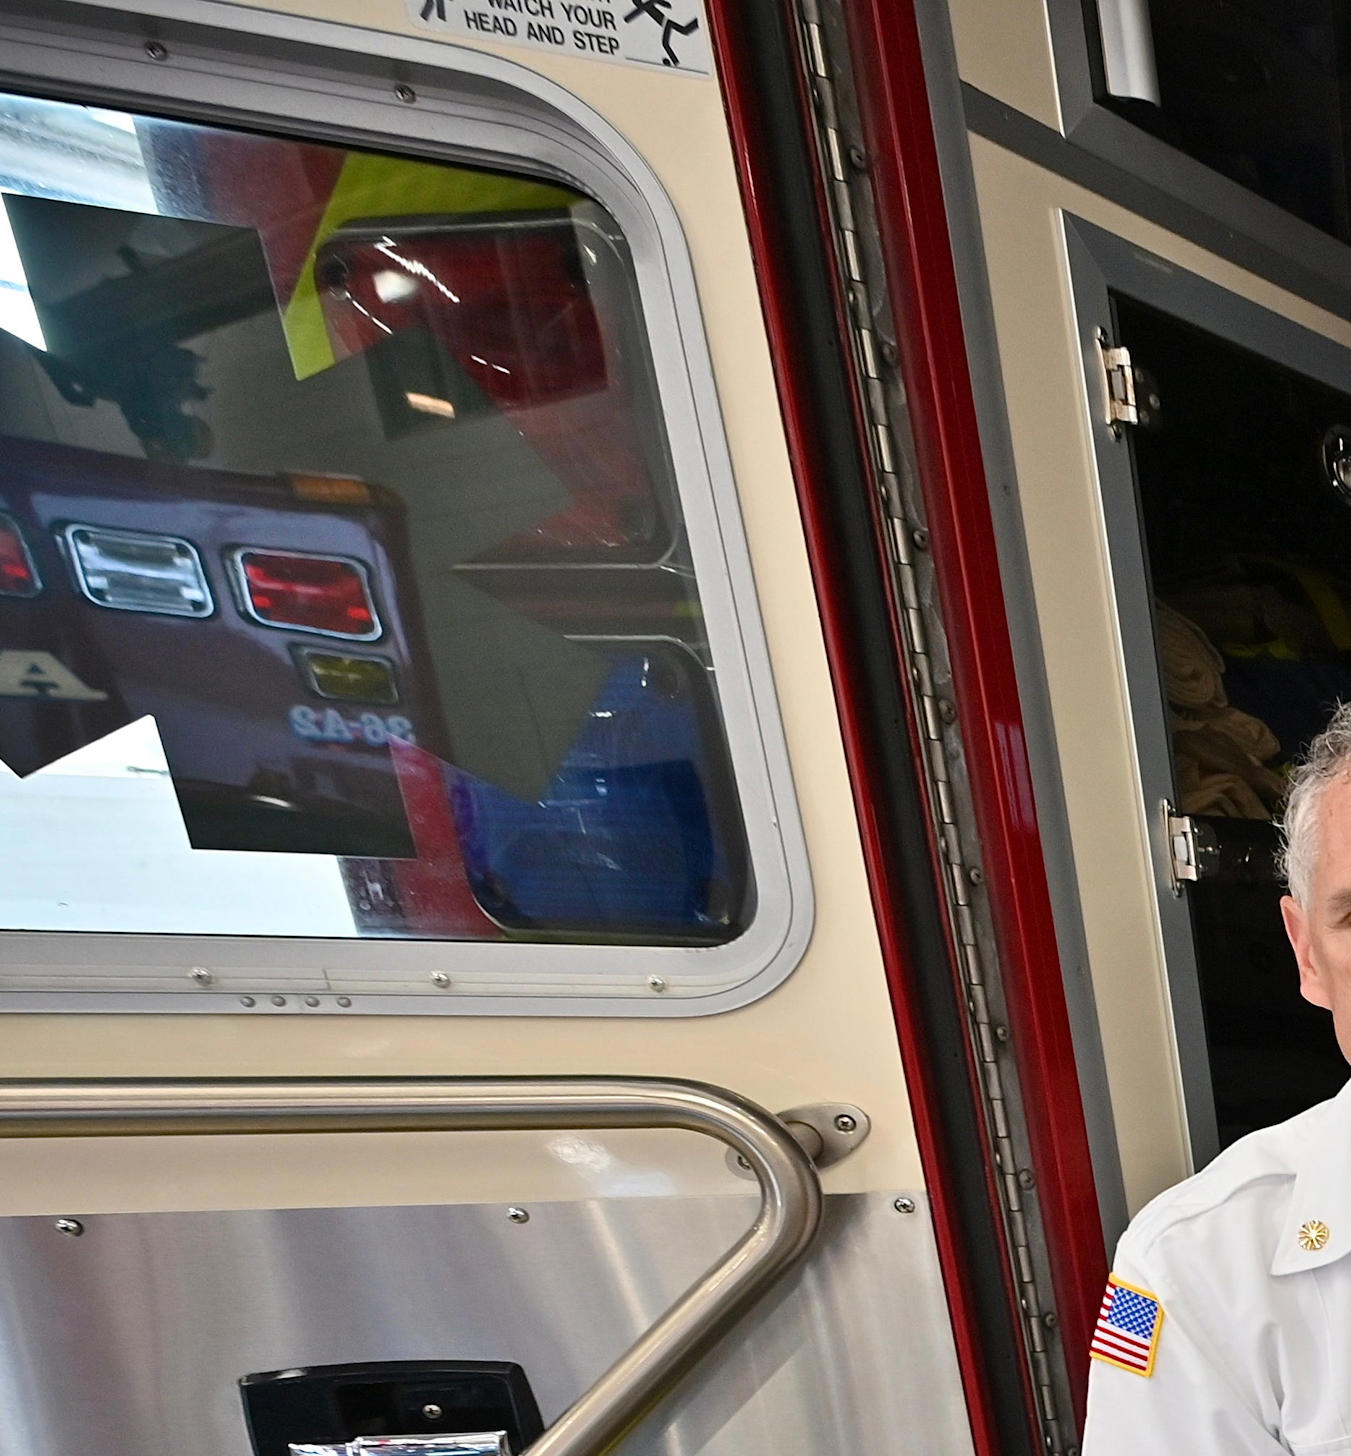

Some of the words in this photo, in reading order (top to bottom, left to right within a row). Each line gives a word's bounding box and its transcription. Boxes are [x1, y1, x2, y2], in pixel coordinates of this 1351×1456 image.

[464, 10, 517, 36] HEAD
[527, 22, 565, 45] AND
[573, 30, 619, 55] STEP
[561, 2, 617, 31] YOUR
